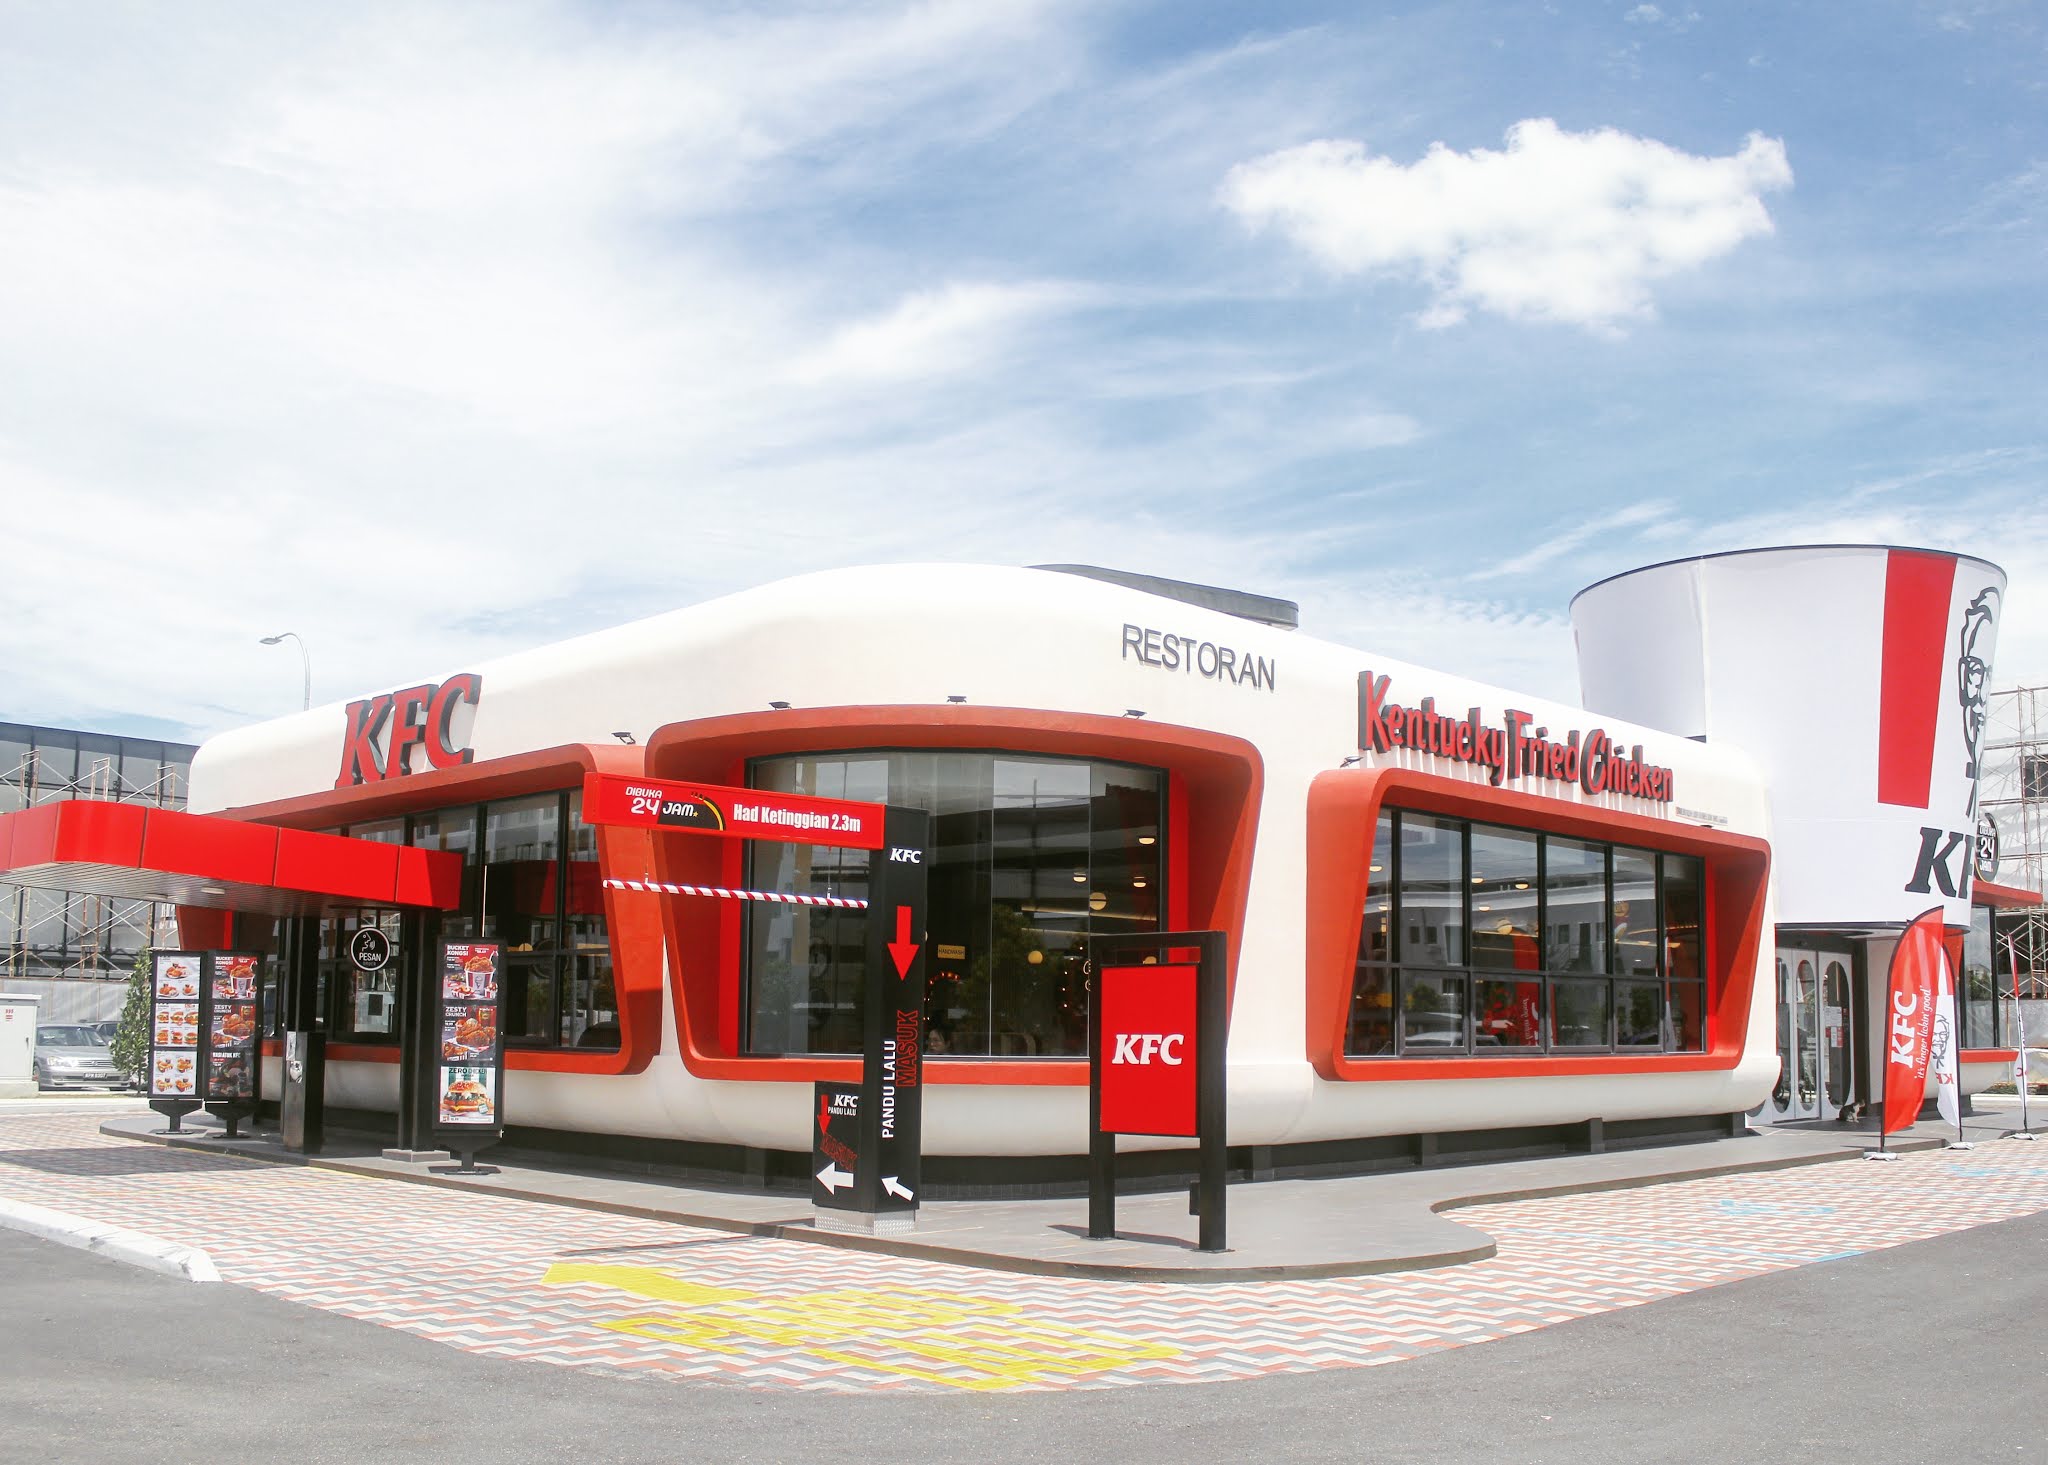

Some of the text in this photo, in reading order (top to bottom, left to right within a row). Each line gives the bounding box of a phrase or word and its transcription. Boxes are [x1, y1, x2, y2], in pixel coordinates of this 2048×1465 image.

[1122, 623, 1275, 692] RESTORAN
[334, 673, 482, 789] KFC
[1358, 670, 1673, 802] Kentucky Fried Chicken
[625, 786, 662, 799] DIBUKA
[630, 797, 694, 817] 24 JAM
[733, 803, 861, 833] Had Ketinggian 2.3m
[890, 847, 922, 864] KFC
[1905, 826, 1974, 899] KF
[1980, 837, 1995, 861] 24
[359, 952, 381, 962] PESAN
[1891, 990, 1917, 1069] KFC
[896, 1009, 919, 1087] MASUK
[1111, 1033, 1185, 1066] KFC
[1915, 1038, 1929, 1065] finger
[834, 1094, 859, 1108] KFC
[881, 1040, 896, 1139] PANDU LALU
[828, 1106, 857, 1116] PANDU LALU
